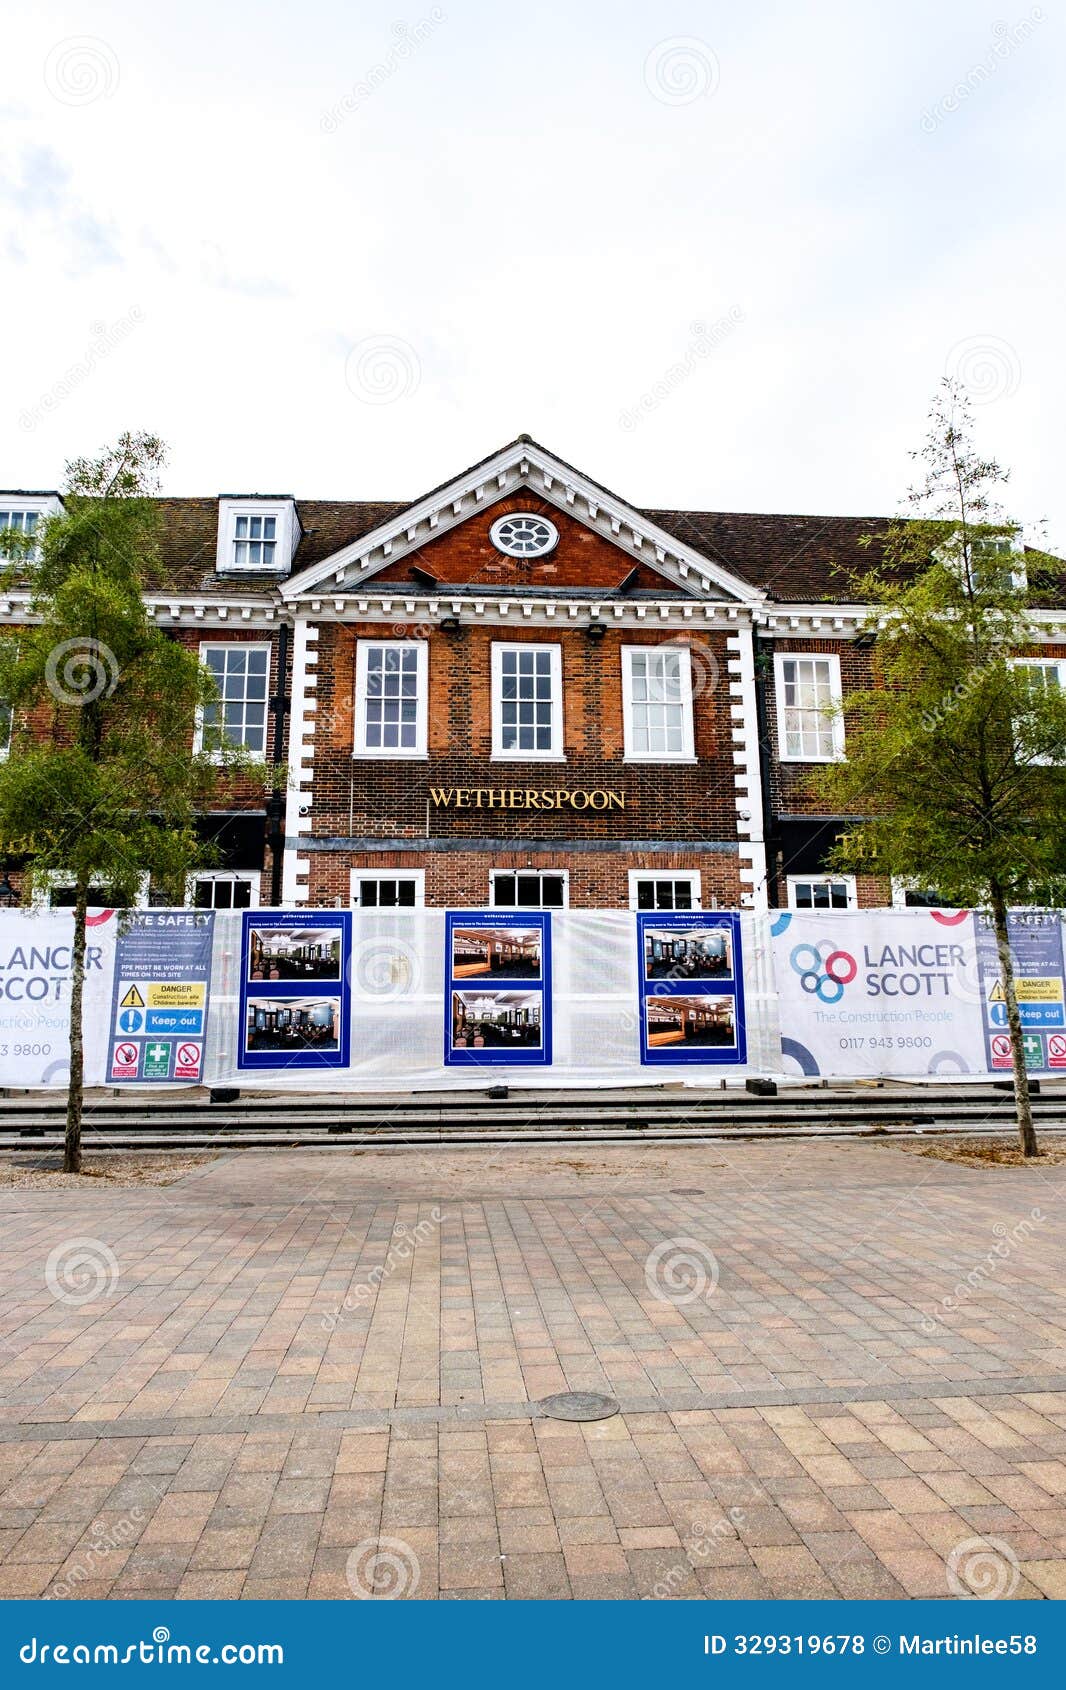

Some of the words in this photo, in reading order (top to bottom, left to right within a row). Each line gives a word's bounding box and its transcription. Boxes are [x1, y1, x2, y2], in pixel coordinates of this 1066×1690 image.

[430, 788, 626, 810] WETHERSPOON
[864, 944, 967, 967] LANCER
[866, 973, 954, 996] SCOTT
[152, 1016, 176, 1026] Keep
[814, 1011, 836, 1022] The
[838, 1010, 912, 1022] Construction
[914, 1010, 952, 1024] People
[1019, 1010, 1042, 1020] Keep
[840, 1038, 865, 1049] 0117
[869, 1038, 894, 1048] 943
[897, 1036, 932, 1048] 9800
[14, 1043, 51, 1056] 9800
